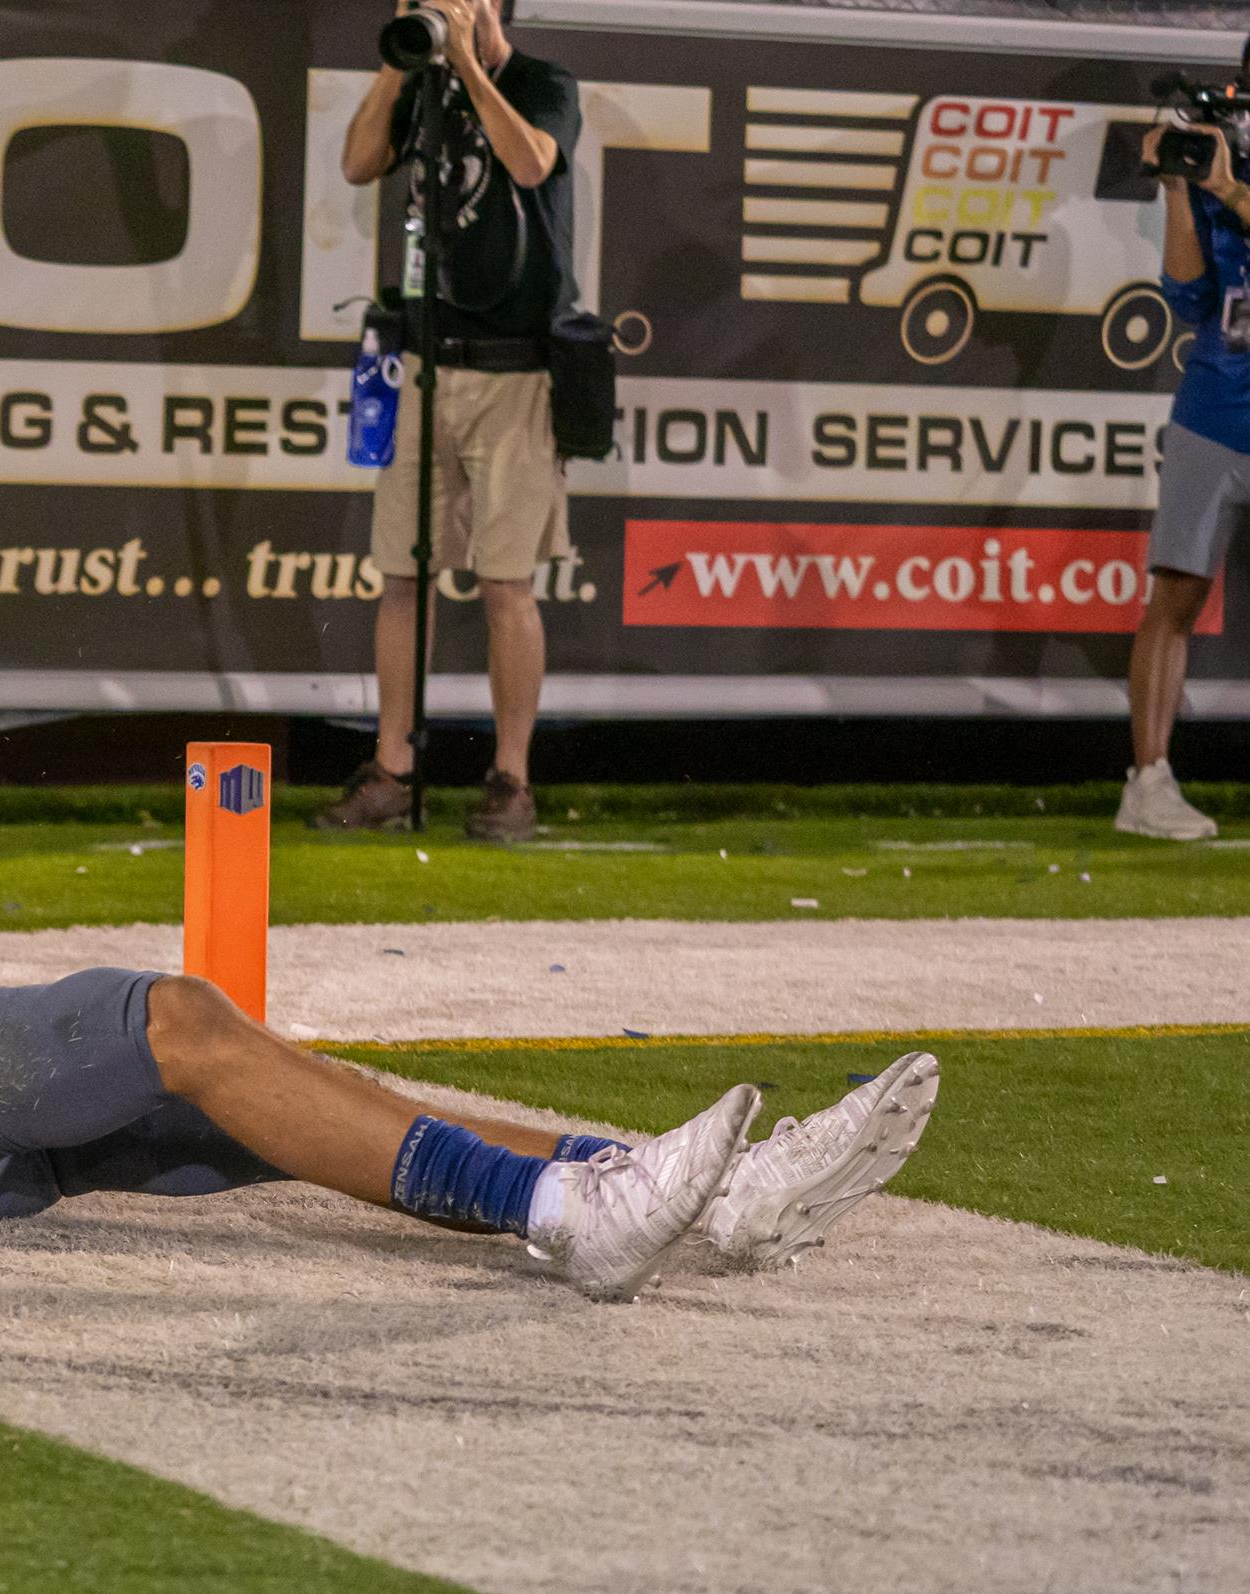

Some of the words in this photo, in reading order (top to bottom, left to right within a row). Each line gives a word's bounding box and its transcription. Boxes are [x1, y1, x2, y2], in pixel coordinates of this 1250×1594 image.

[930, 103, 1075, 143] COIT
[921, 144, 1066, 185] COIT
[914, 186, 1058, 227] COIT
[904, 228, 1048, 268] COIT
[76, 393, 139, 453] &
[161, 395, 769, 467] RESION
[812, 412, 1165, 477] SERVICE
[246, 539, 386, 600] trus
[685, 538, 1153, 605] www.coit.co
